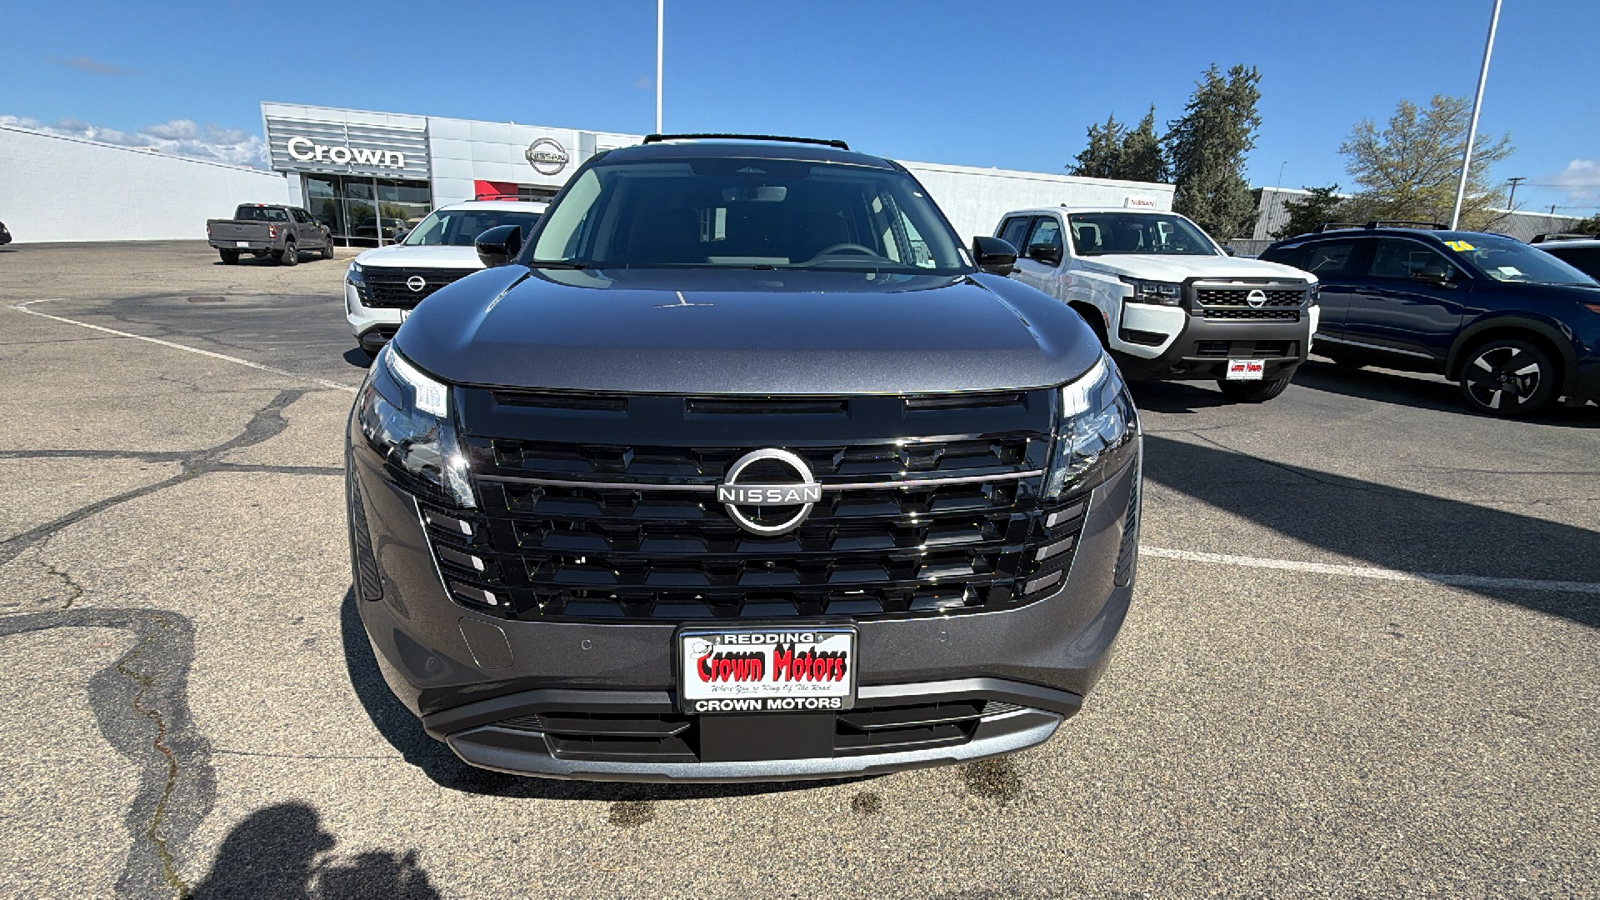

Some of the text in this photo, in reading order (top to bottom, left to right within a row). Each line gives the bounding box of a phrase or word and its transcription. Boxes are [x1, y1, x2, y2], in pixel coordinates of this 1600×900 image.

[287, 136, 405, 168] Crown
[529, 152, 566, 161] NISSAN
[1130, 199, 1155, 207] NISSAN
[719, 487, 819, 503] NISSAN
[724, 633, 814, 644] REDDING
[696, 646, 847, 683] Crown Motors
[762, 684, 780, 693] King
[782, 683, 793, 693] Of
[794, 683, 809, 692] The
[811, 684, 832, 692] Road
[695, 697, 842, 712] CROWN MOTORS
